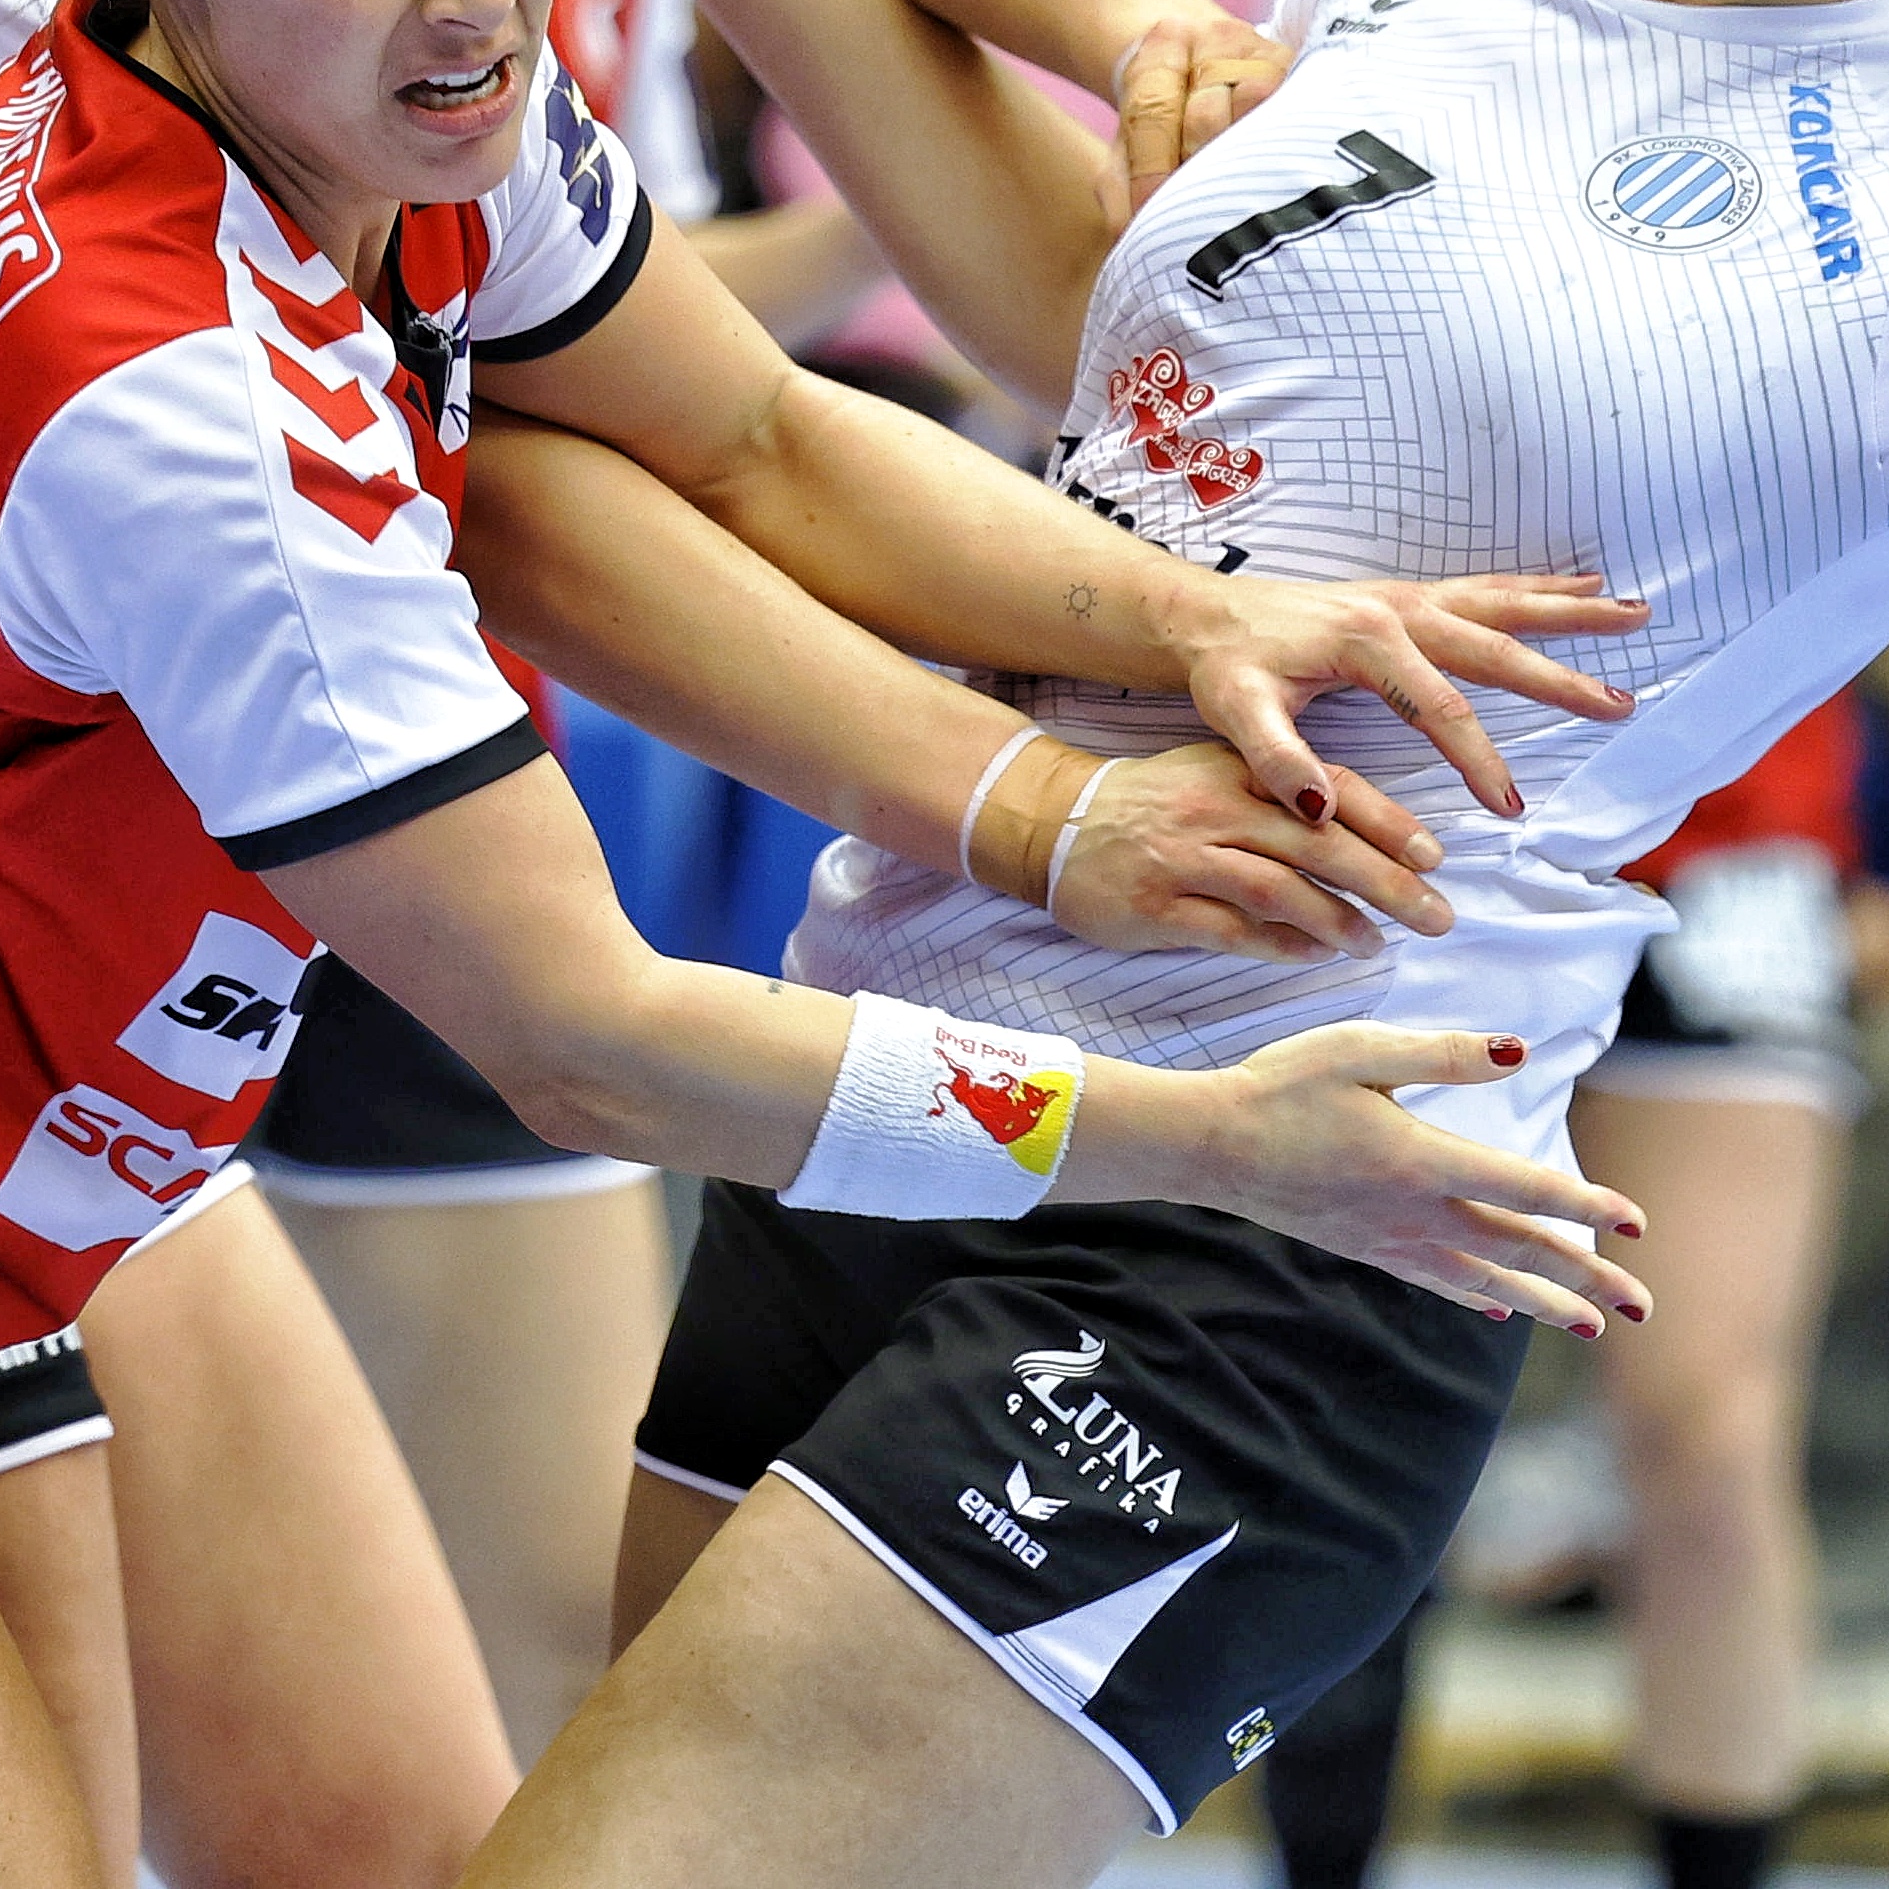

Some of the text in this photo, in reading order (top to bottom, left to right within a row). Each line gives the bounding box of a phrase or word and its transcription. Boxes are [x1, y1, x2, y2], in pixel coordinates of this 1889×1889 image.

[1186, 130, 1436, 302] 7
[1593, 198, 1667, 243] 1949
[1641, 139, 1748, 174] LOKOMOTIVA
[1720, 176, 1755, 226] ZAGREB
[1187, 461, 1252, 492] ZAGREB
[935, 1026, 1027, 1067] Red Bull
[1012, 1329, 1183, 1516] LUNA
[955, 1486, 1051, 1571] erima
